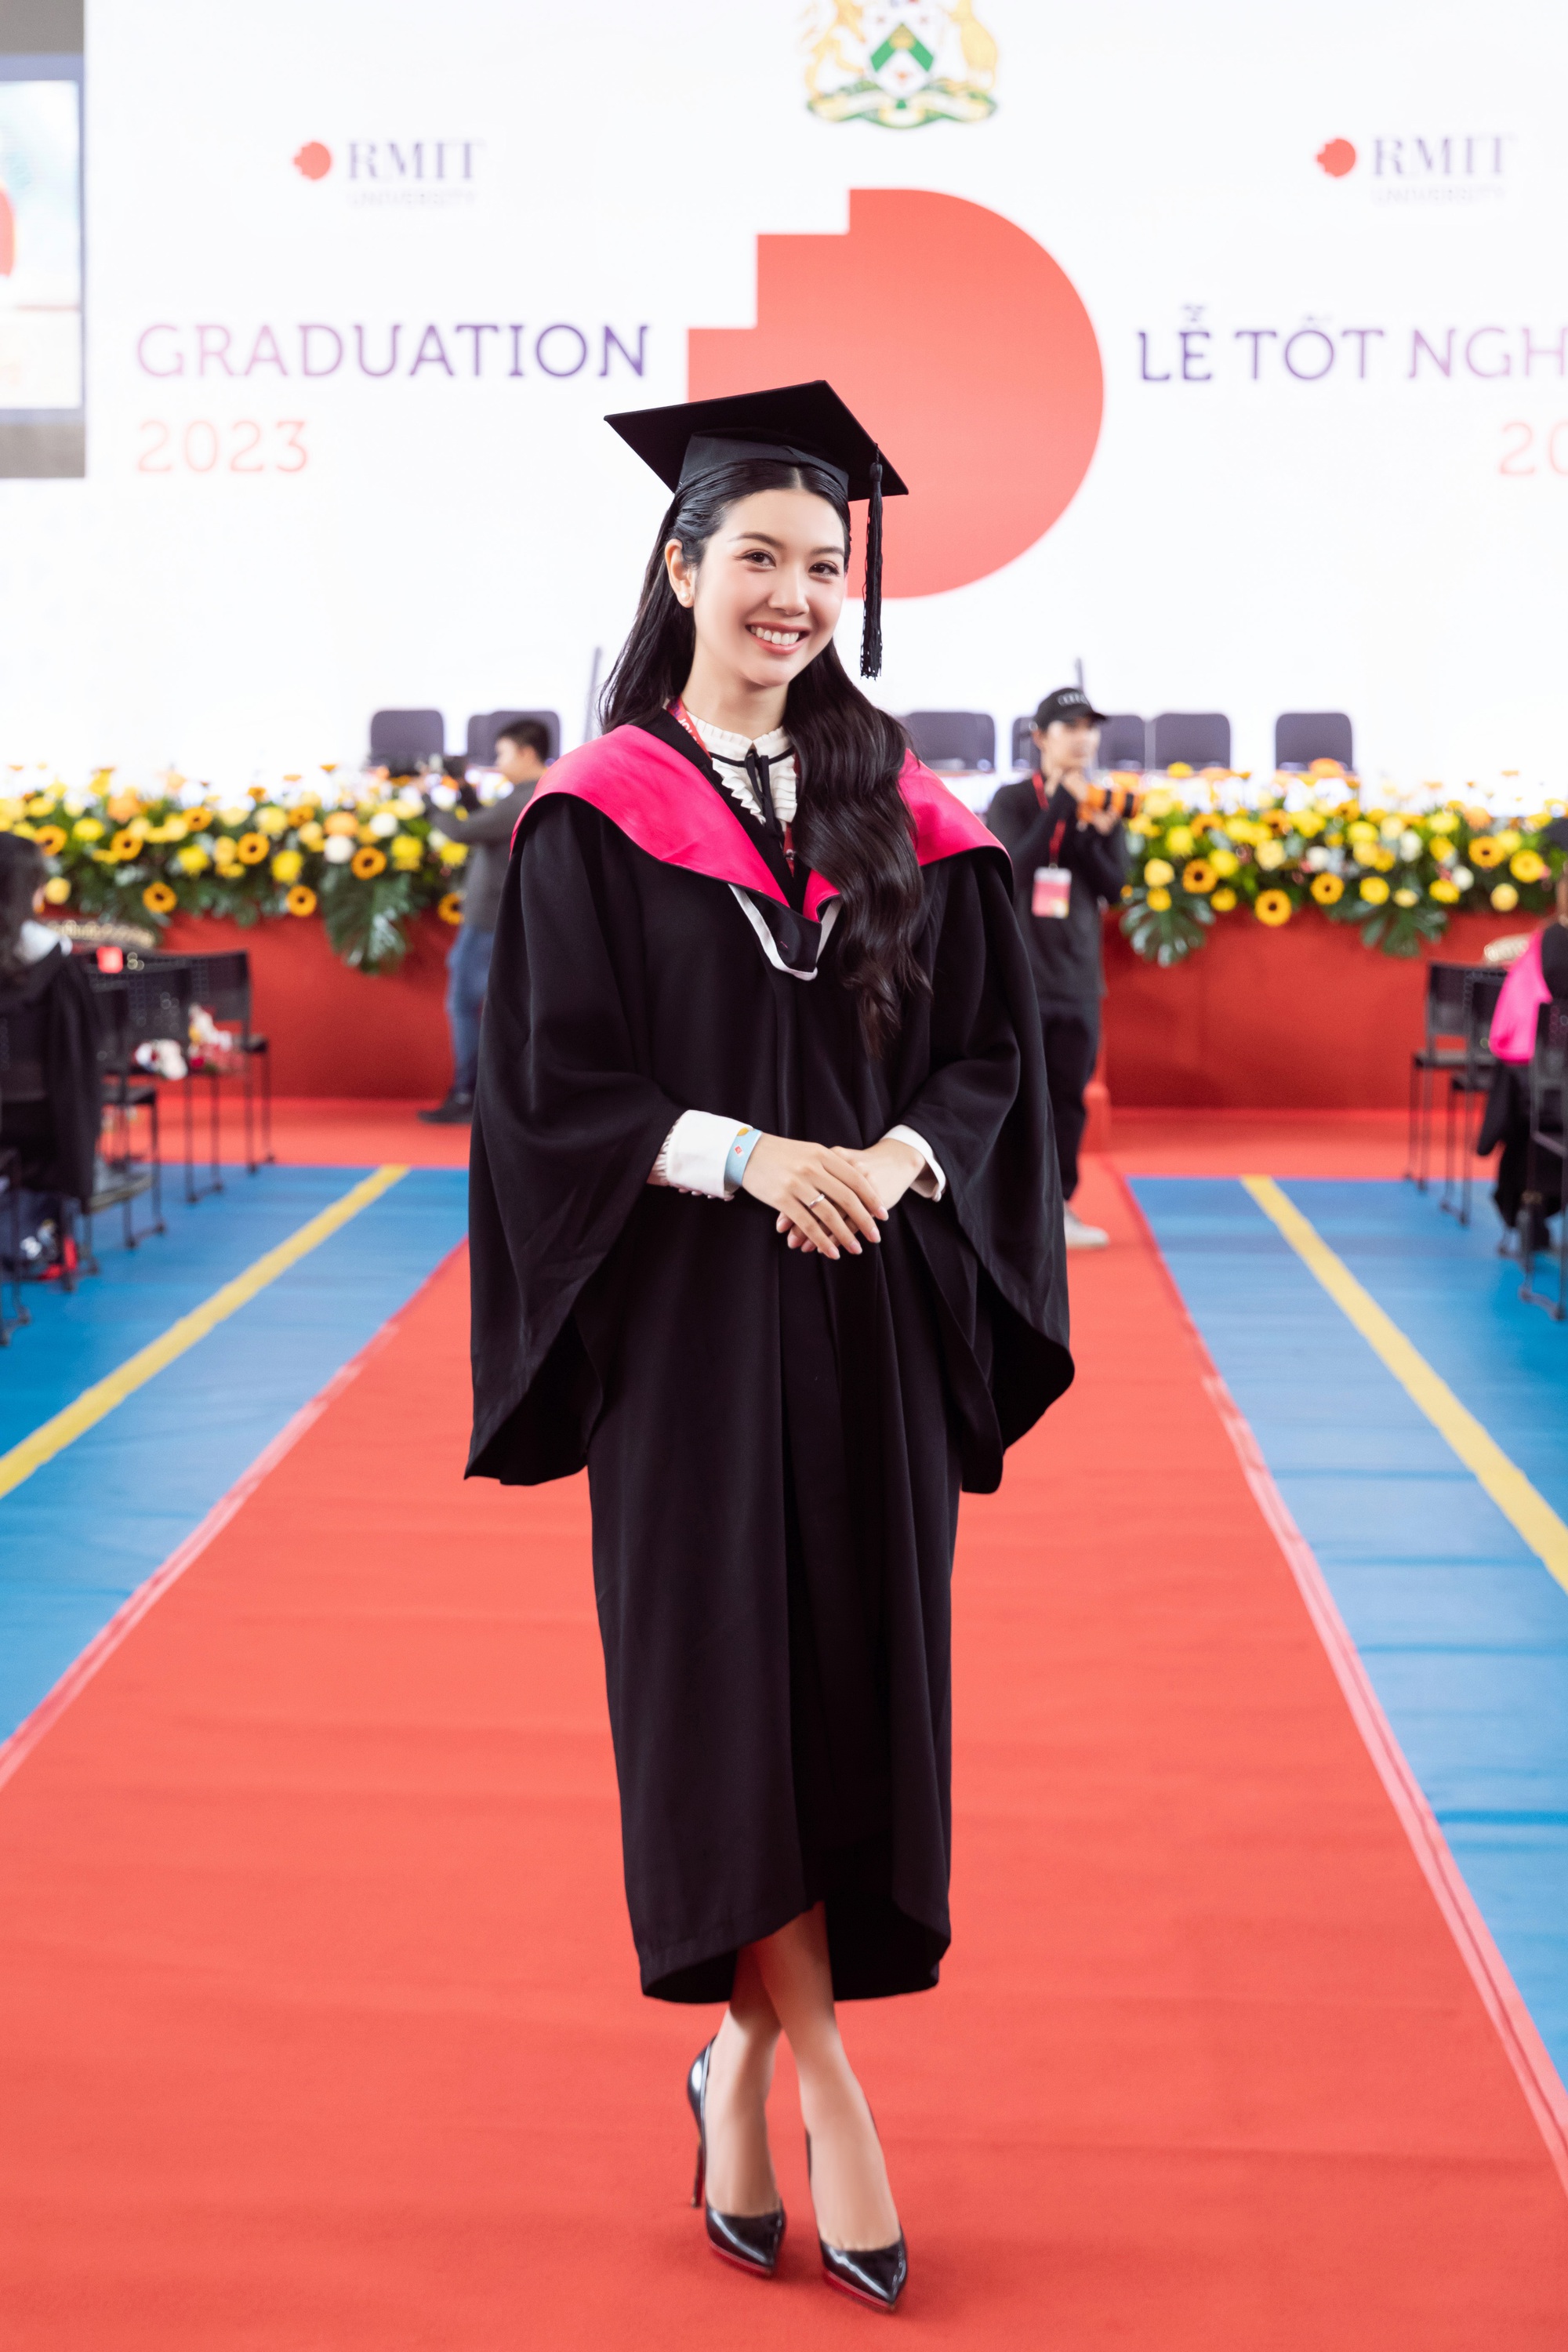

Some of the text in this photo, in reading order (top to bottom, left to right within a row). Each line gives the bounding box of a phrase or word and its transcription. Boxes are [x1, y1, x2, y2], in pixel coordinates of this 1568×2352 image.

[350, 140, 484, 181] RMIT
[1374, 136, 1513, 178] RMIT
[136, 321, 652, 381] GRADUATION
[137, 419, 310, 475] 2023
